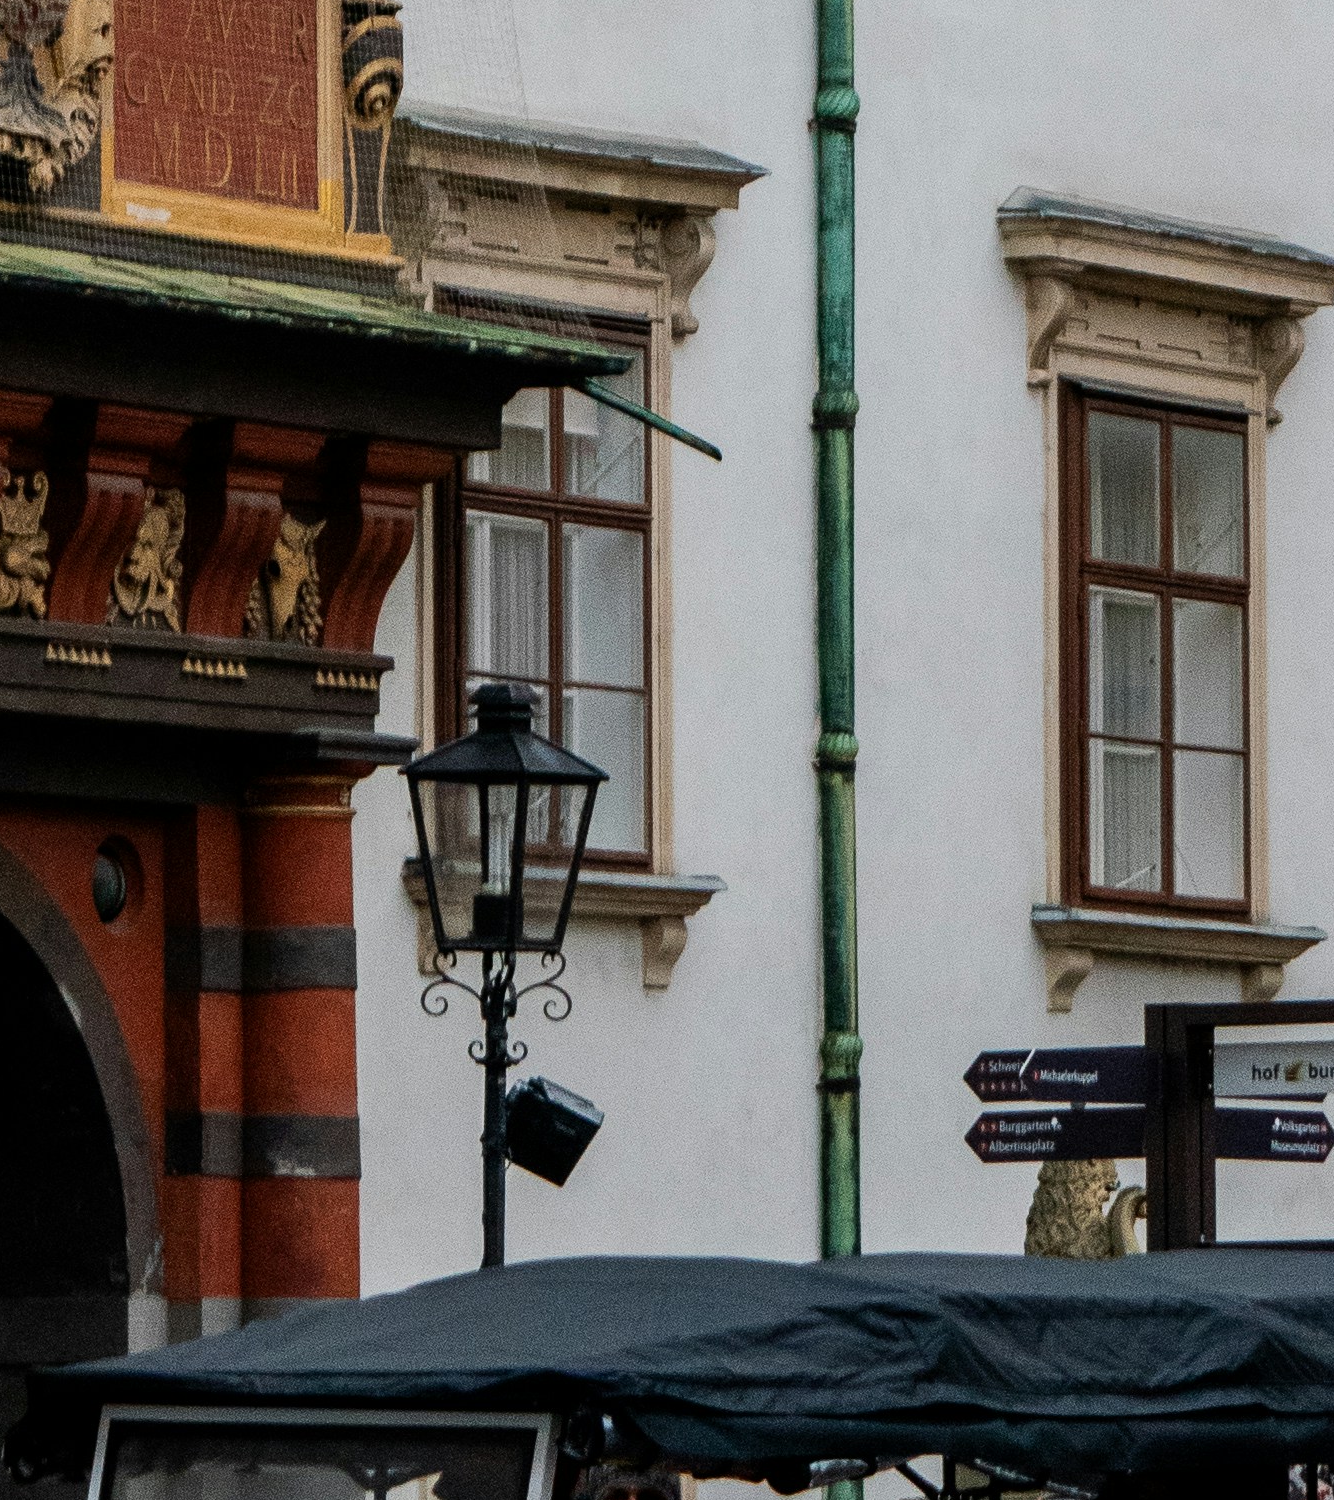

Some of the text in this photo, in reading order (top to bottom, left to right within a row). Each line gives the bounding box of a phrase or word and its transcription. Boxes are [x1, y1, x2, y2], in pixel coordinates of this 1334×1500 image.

[123, 50, 235, 118] GVND
[999, 1120, 1051, 1135] Burggarten
[988, 1138, 1056, 1154] Albertinaplatz
